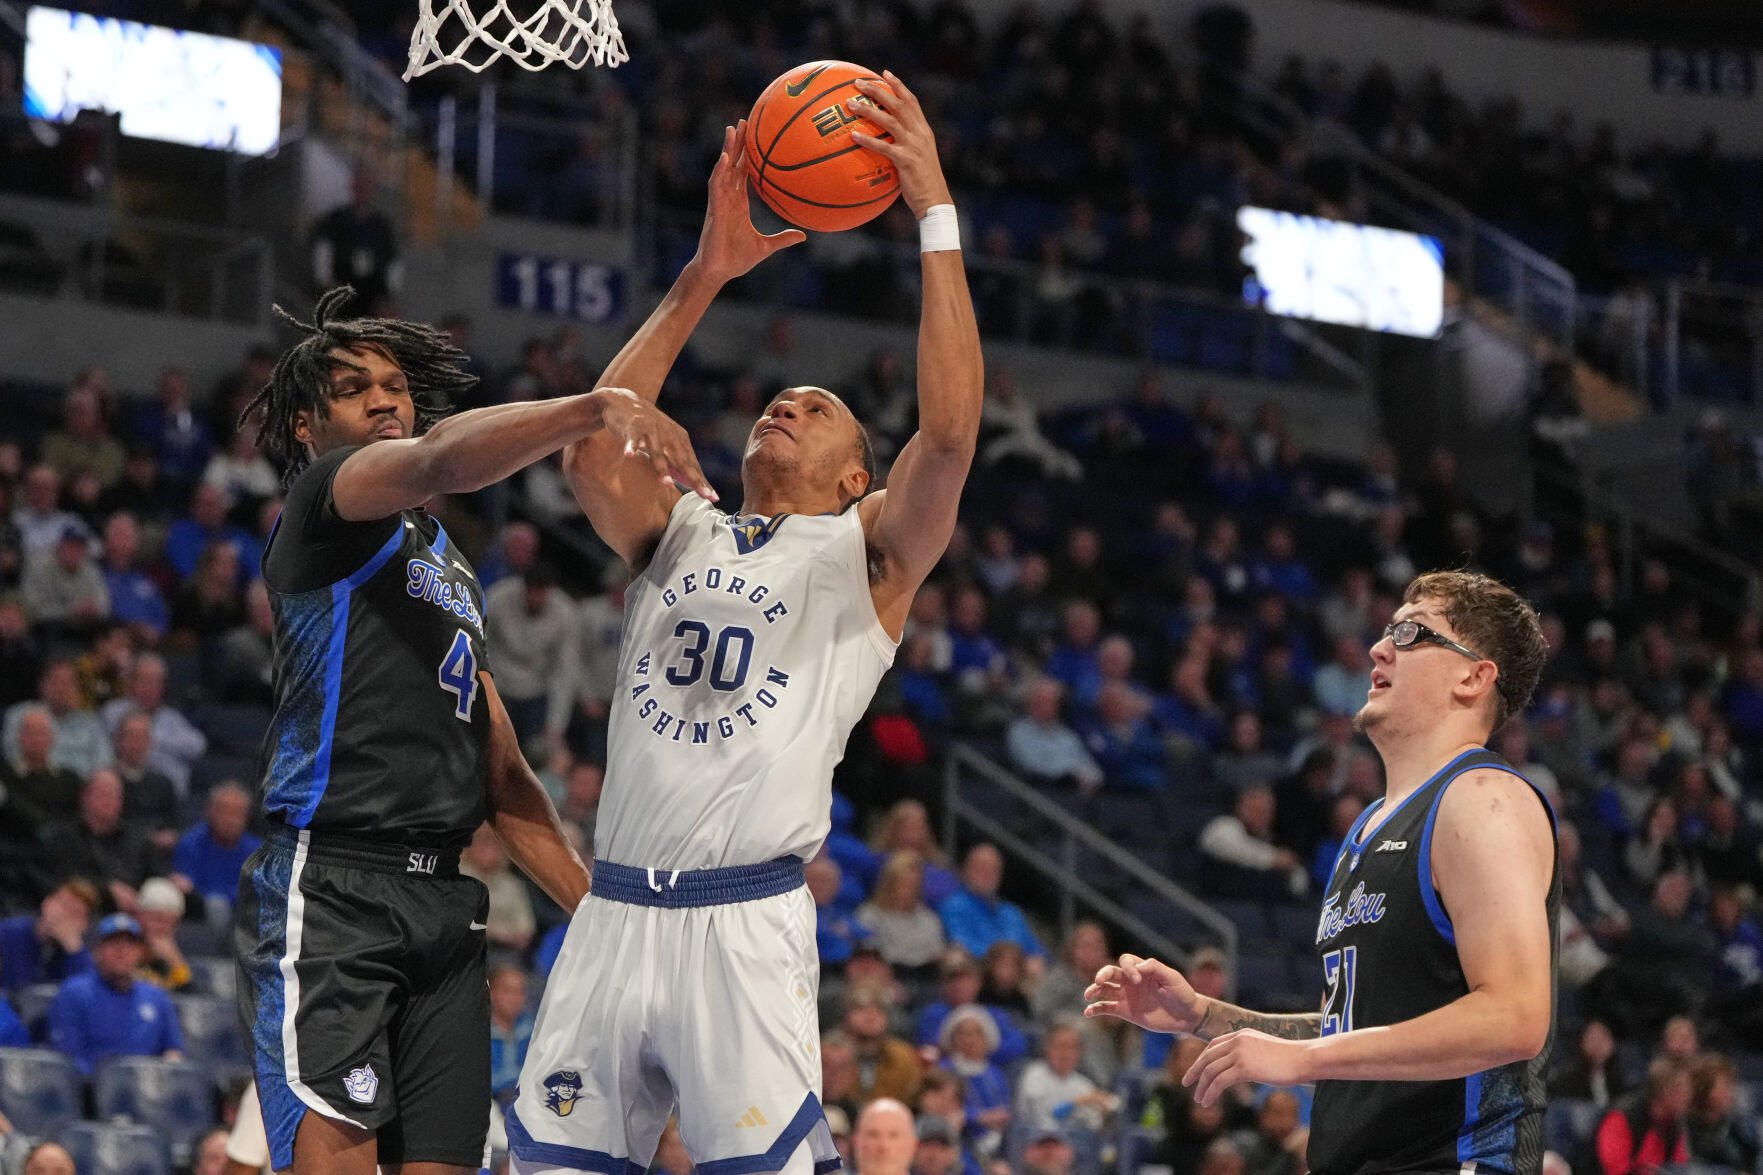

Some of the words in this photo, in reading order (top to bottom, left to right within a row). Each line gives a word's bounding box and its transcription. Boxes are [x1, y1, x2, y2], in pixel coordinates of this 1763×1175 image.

[512, 260, 612, 320] 115
[407, 558, 452, 611] The
[661, 567, 790, 625] GEORGE
[438, 627, 479, 724] 4
[664, 617, 756, 694] 30
[631, 650, 791, 745] WASHINGTON
[406, 852, 438, 874] SLU
[1315, 890, 1343, 944] The
[1339, 880, 1387, 930] Lou
[1320, 945, 1357, 1038] 21
